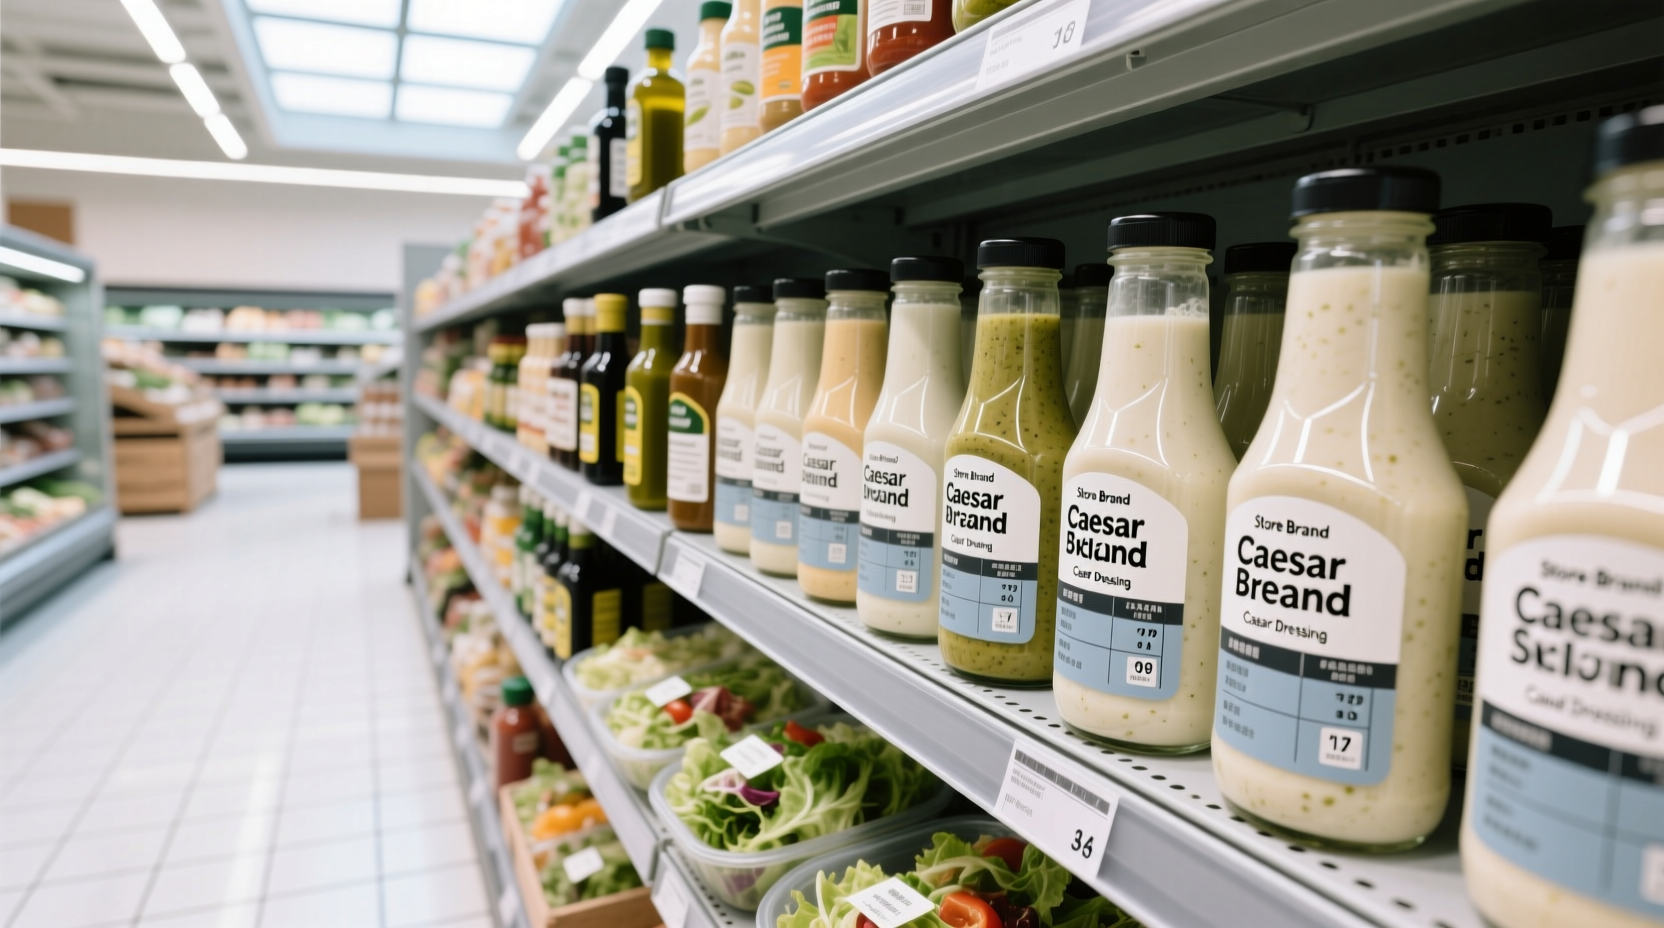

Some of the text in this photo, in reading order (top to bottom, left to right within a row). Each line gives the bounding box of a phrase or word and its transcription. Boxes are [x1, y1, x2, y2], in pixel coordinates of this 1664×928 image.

[946, 482, 1004, 510] Caesar
[1068, 504, 1145, 538] Caesar
[1286, 520, 1330, 539] Brand
[1238, 535, 1346, 580] Caesar
[1236, 567, 1352, 617] Breand
[1514, 586, 1664, 648] Caesa
